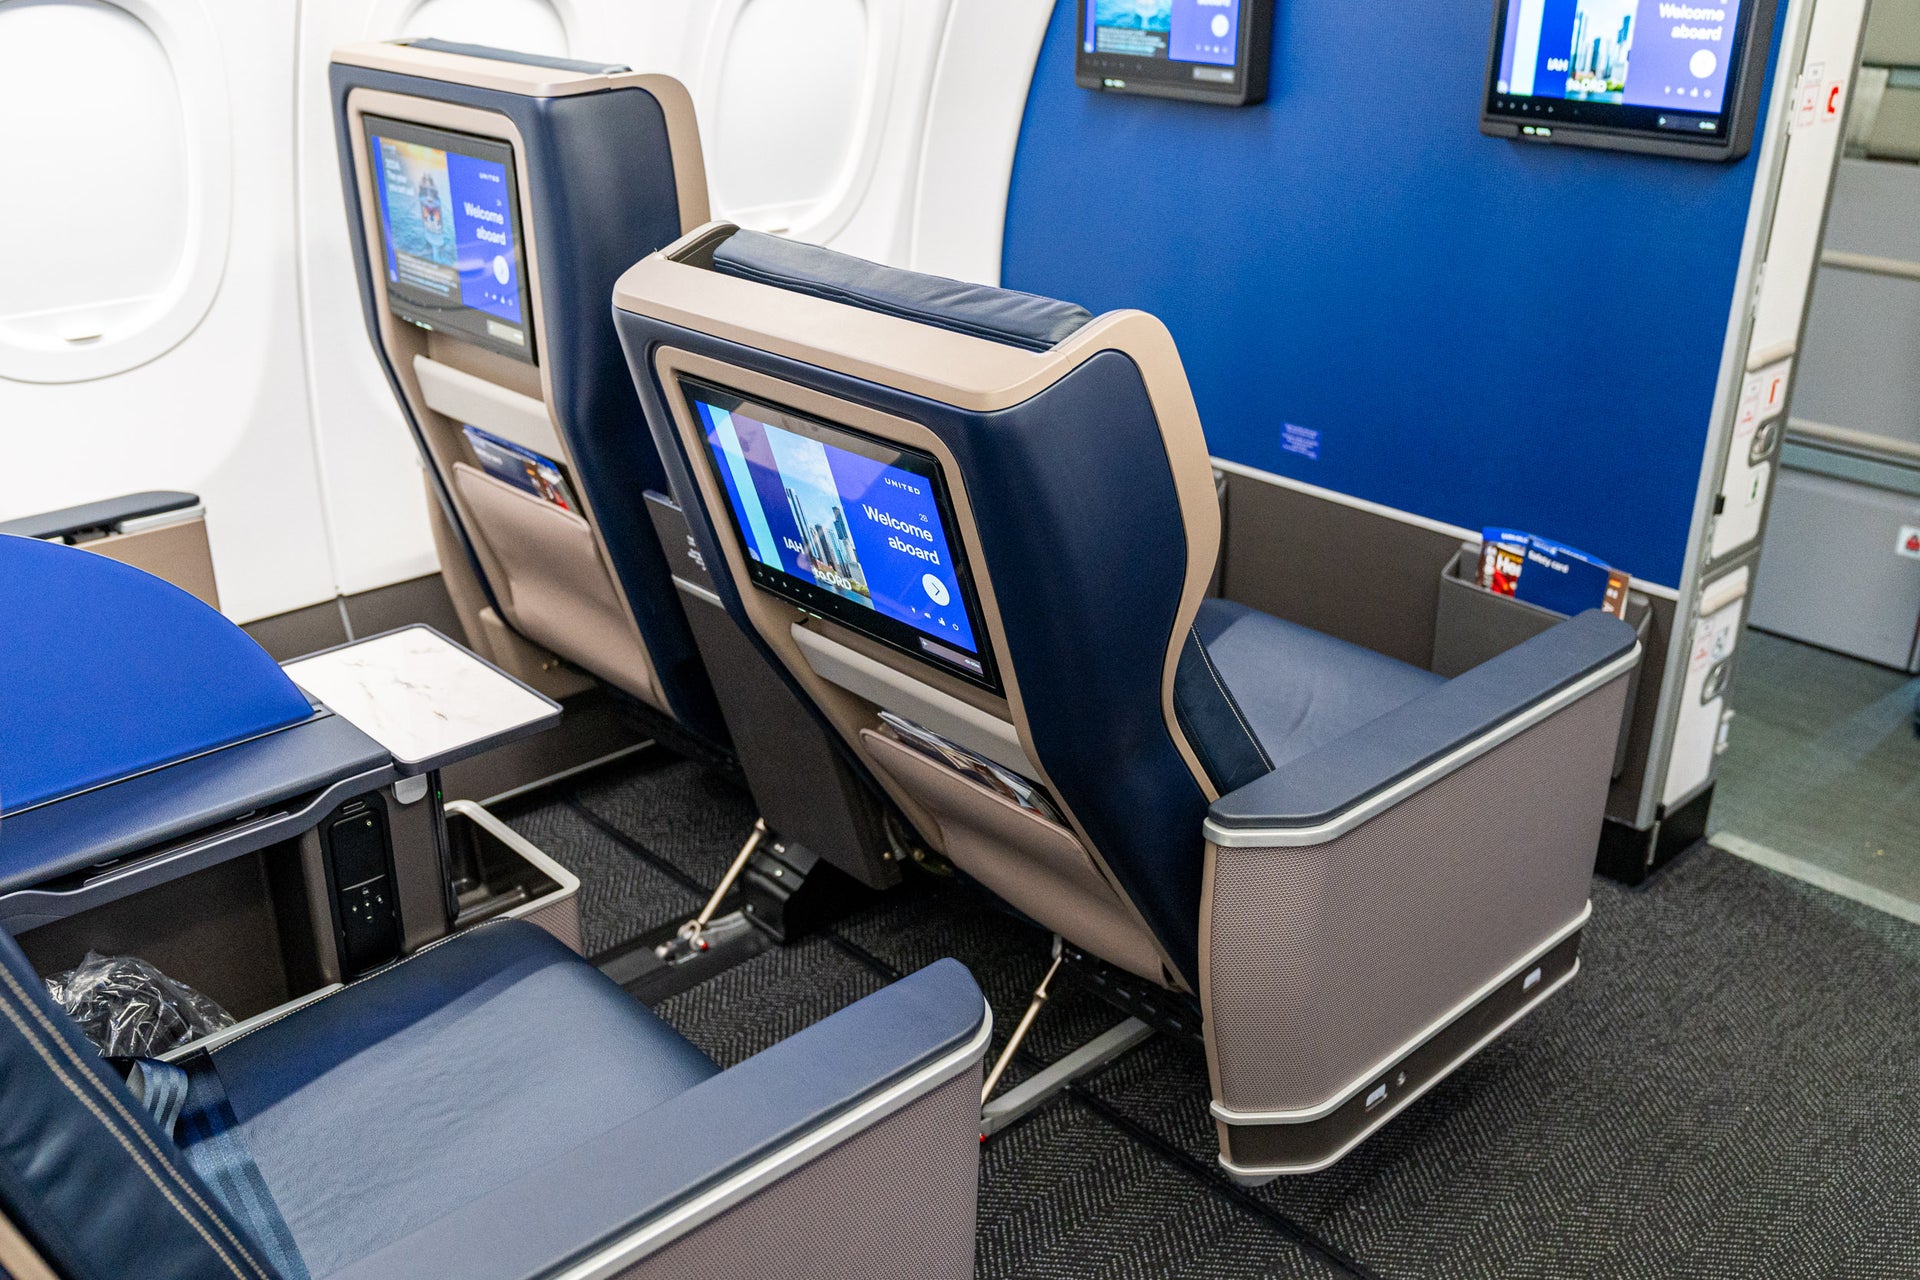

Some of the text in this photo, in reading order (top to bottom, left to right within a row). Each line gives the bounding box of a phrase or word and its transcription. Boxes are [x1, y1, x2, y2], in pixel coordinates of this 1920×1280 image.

[1659, 2, 1726, 22] Welcome
[1671, 23, 1723, 41] aboard
[463, 201, 504, 225] Welcome
[476, 226, 507, 246] aboard
[884, 477, 921, 495] UNITED
[862, 503, 934, 542] Welcome
[783, 536, 805, 555] IAH
[887, 536, 940, 566] aboard
[826, 571, 852, 590] ORD
